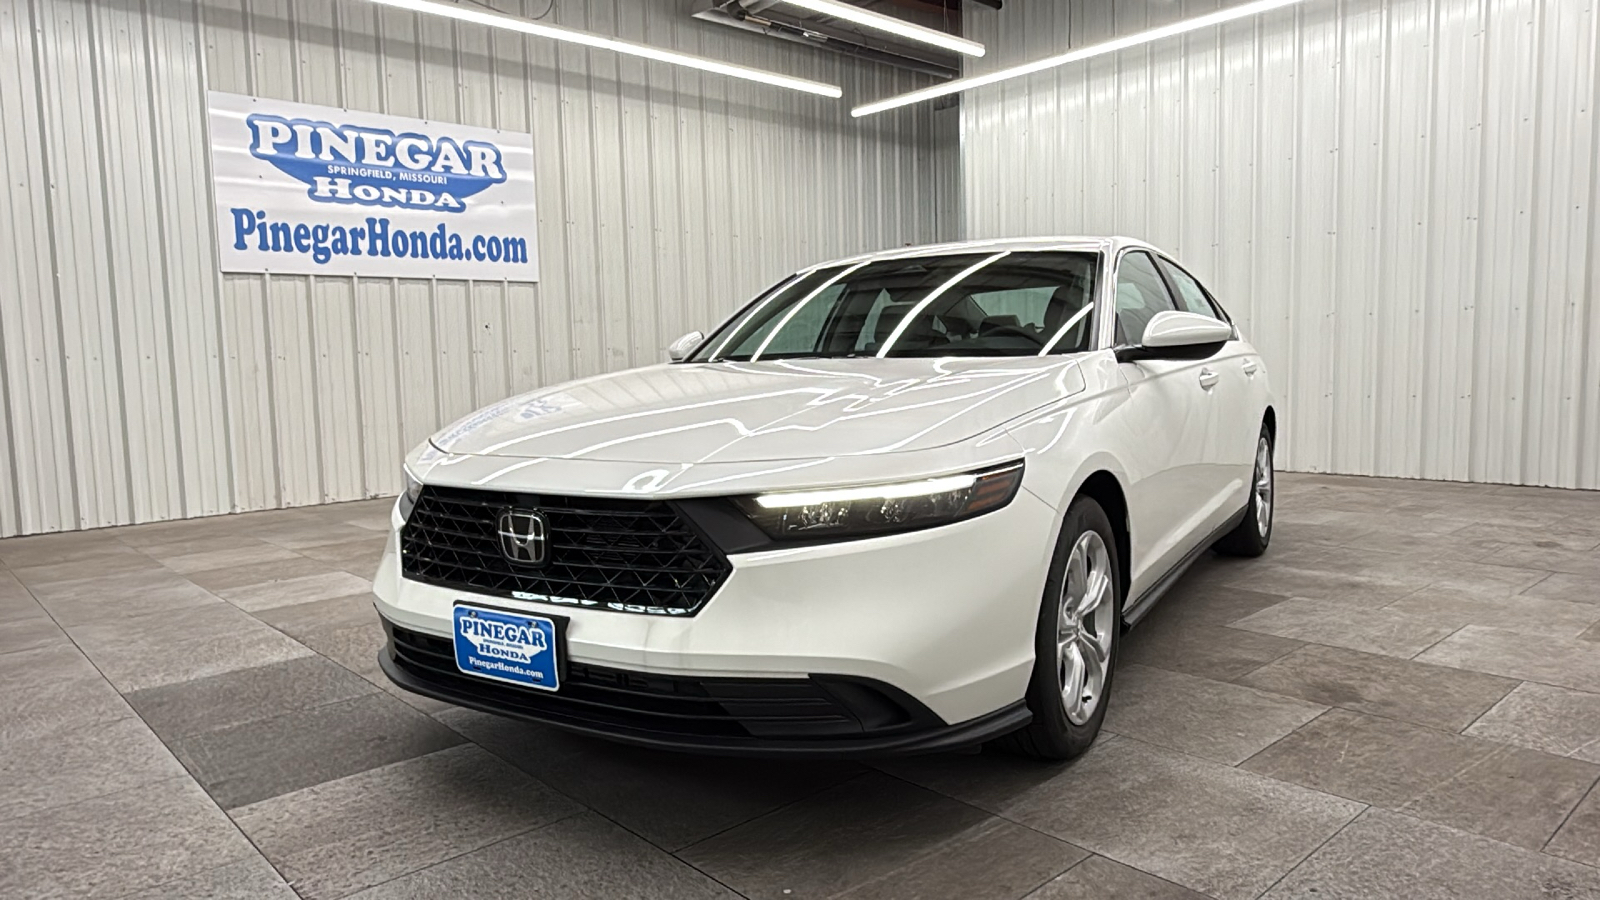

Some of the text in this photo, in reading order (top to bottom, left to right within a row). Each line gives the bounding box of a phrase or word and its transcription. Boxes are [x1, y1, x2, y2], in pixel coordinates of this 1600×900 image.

[252, 119, 503, 179] PINEGAR
[327, 164, 448, 185] SPRINGFIELD, MISSOURI
[313, 176, 461, 208] HONDA
[231, 208, 528, 264] PinegarHonda.com
[462, 619, 545, 648] PINEGAR
[479, 643, 529, 661] HONDA
[468, 656, 544, 678] PinegarHonda.com
